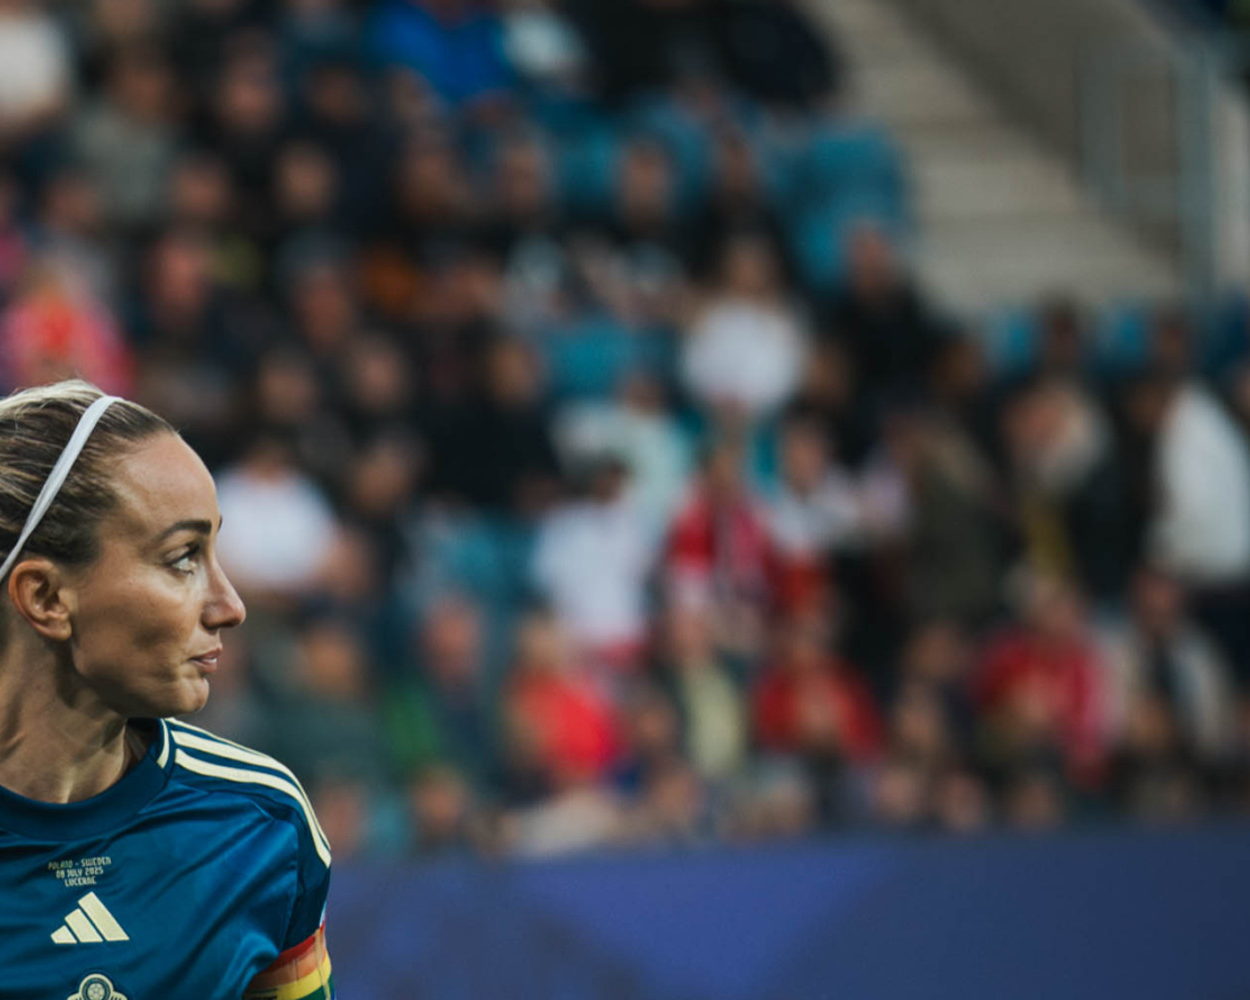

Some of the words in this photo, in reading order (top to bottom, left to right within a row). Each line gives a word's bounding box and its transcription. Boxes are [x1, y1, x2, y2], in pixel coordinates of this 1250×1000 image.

[81, 857, 111, 866] SWEDEN
[67, 868, 83, 877] JULY
[85, 866, 103, 875] 2025
[65, 876, 96, 886] LUCERNE
